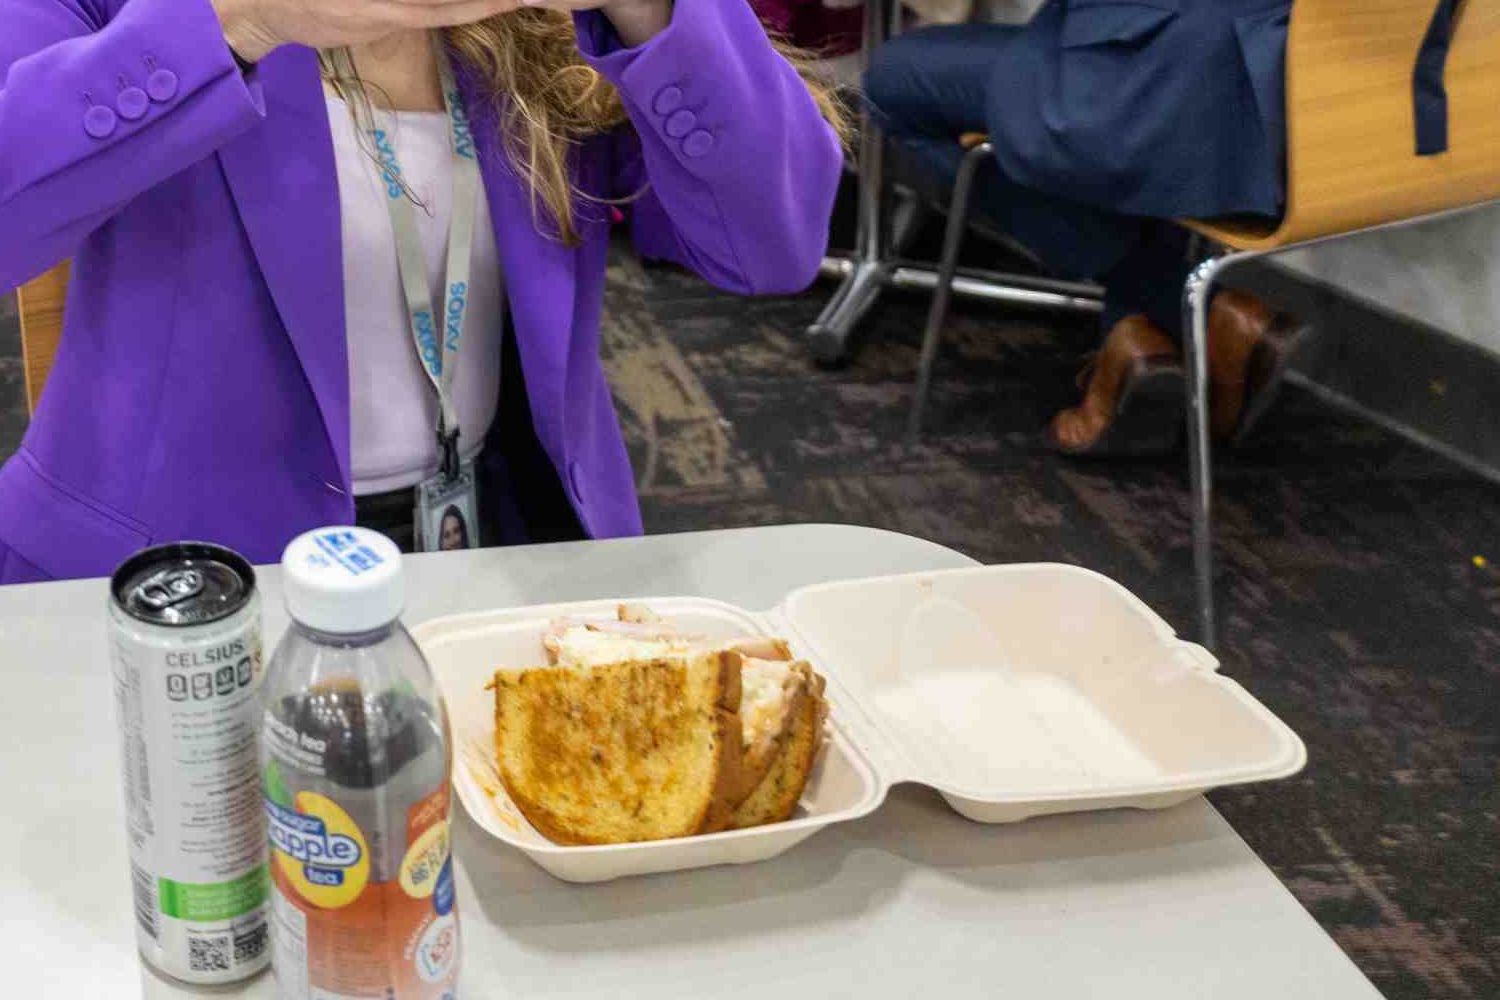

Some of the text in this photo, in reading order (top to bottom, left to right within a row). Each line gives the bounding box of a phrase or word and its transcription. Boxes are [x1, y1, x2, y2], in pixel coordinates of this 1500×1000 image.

[446, 281, 467, 352] AXIOS
[165, 637, 245, 668] CELSIUS
[307, 868, 340, 885] tea
